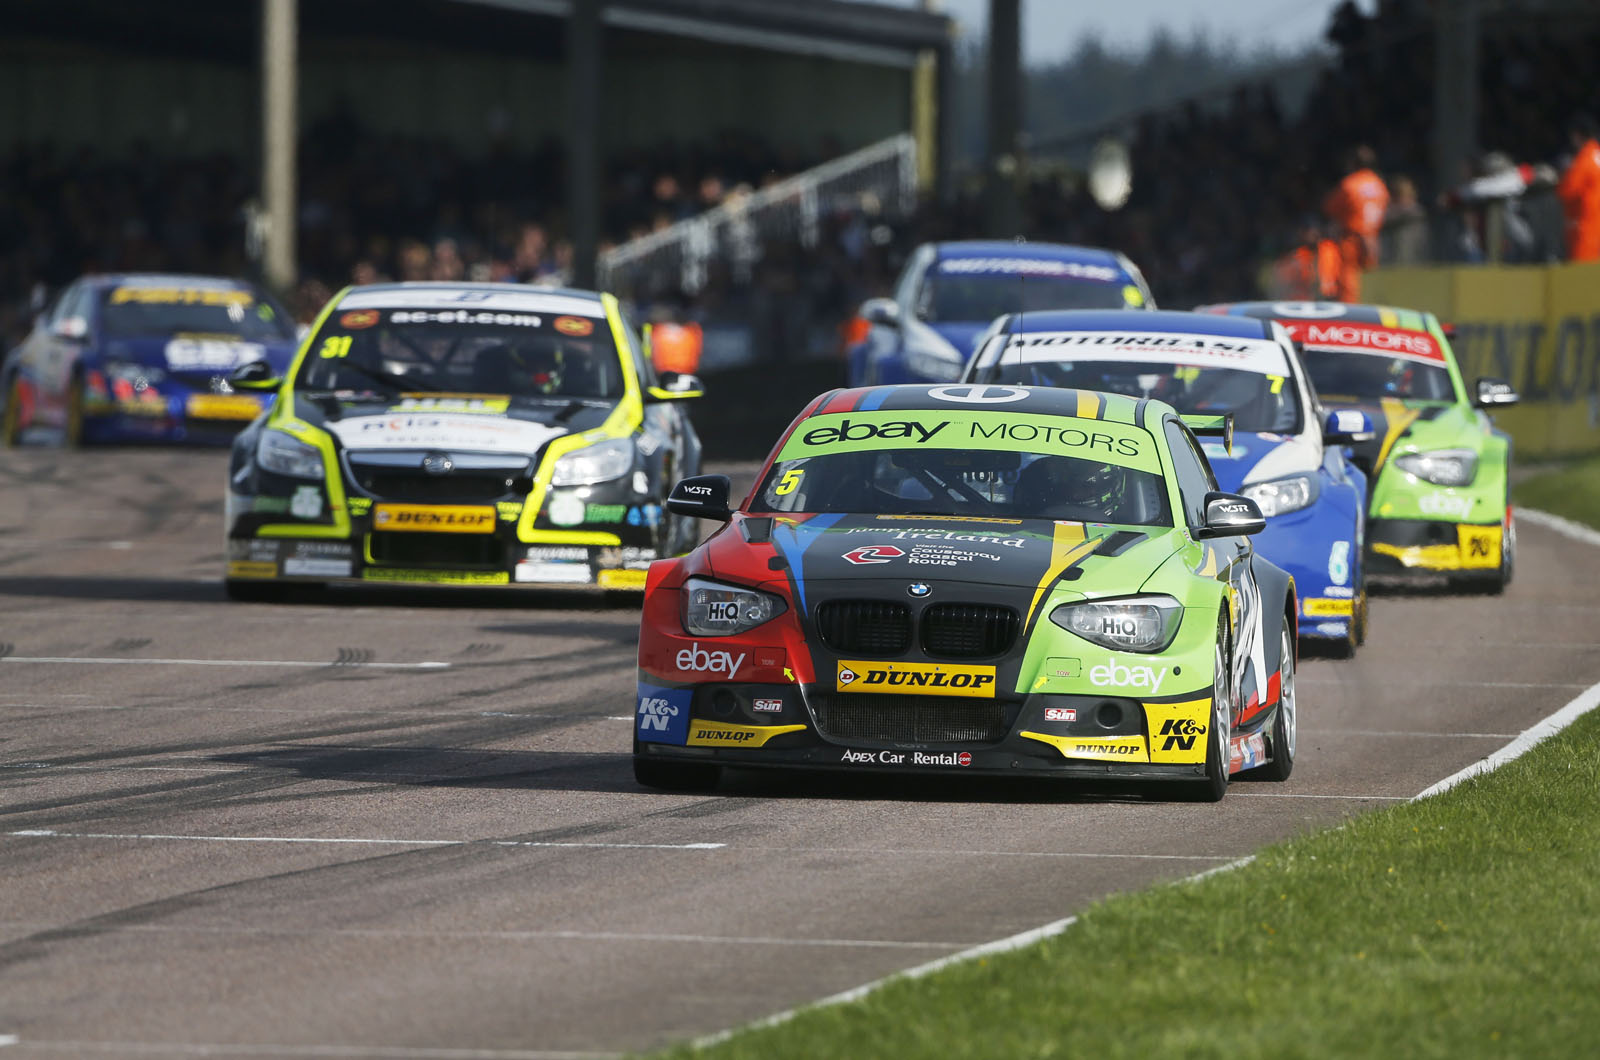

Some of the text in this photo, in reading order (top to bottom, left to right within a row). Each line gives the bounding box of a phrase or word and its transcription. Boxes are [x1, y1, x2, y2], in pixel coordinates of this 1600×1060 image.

[320, 336, 353, 358] 31
[1307, 324, 1432, 355] MOTORS
[1266, 374, 1285, 394] 7
[803, 420, 1139, 457] ebay MOTORS
[683, 485, 712, 496] WSR
[775, 469, 804, 496] 5
[1219, 504, 1250, 514] WSR
[395, 510, 494, 526] DUNLOP
[892, 530, 1027, 549] Ireland
[908, 557, 958, 567] Route
[909, 552, 974, 562] Coastal
[911, 547, 1001, 561] Causeway
[708, 602, 739, 620] HiQ
[1102, 617, 1136, 636] HiQ
[676, 642, 746, 679] ebay
[863, 670, 994, 688] DUNLOP
[1089, 657, 1168, 694] ebay
[754, 700, 782, 712] Sun
[1046, 709, 1076, 721] Sun
[695, 729, 755, 742] DUNLOP
[879, 751, 905, 763] Car
[1074, 744, 1140, 755] DUNLOP
